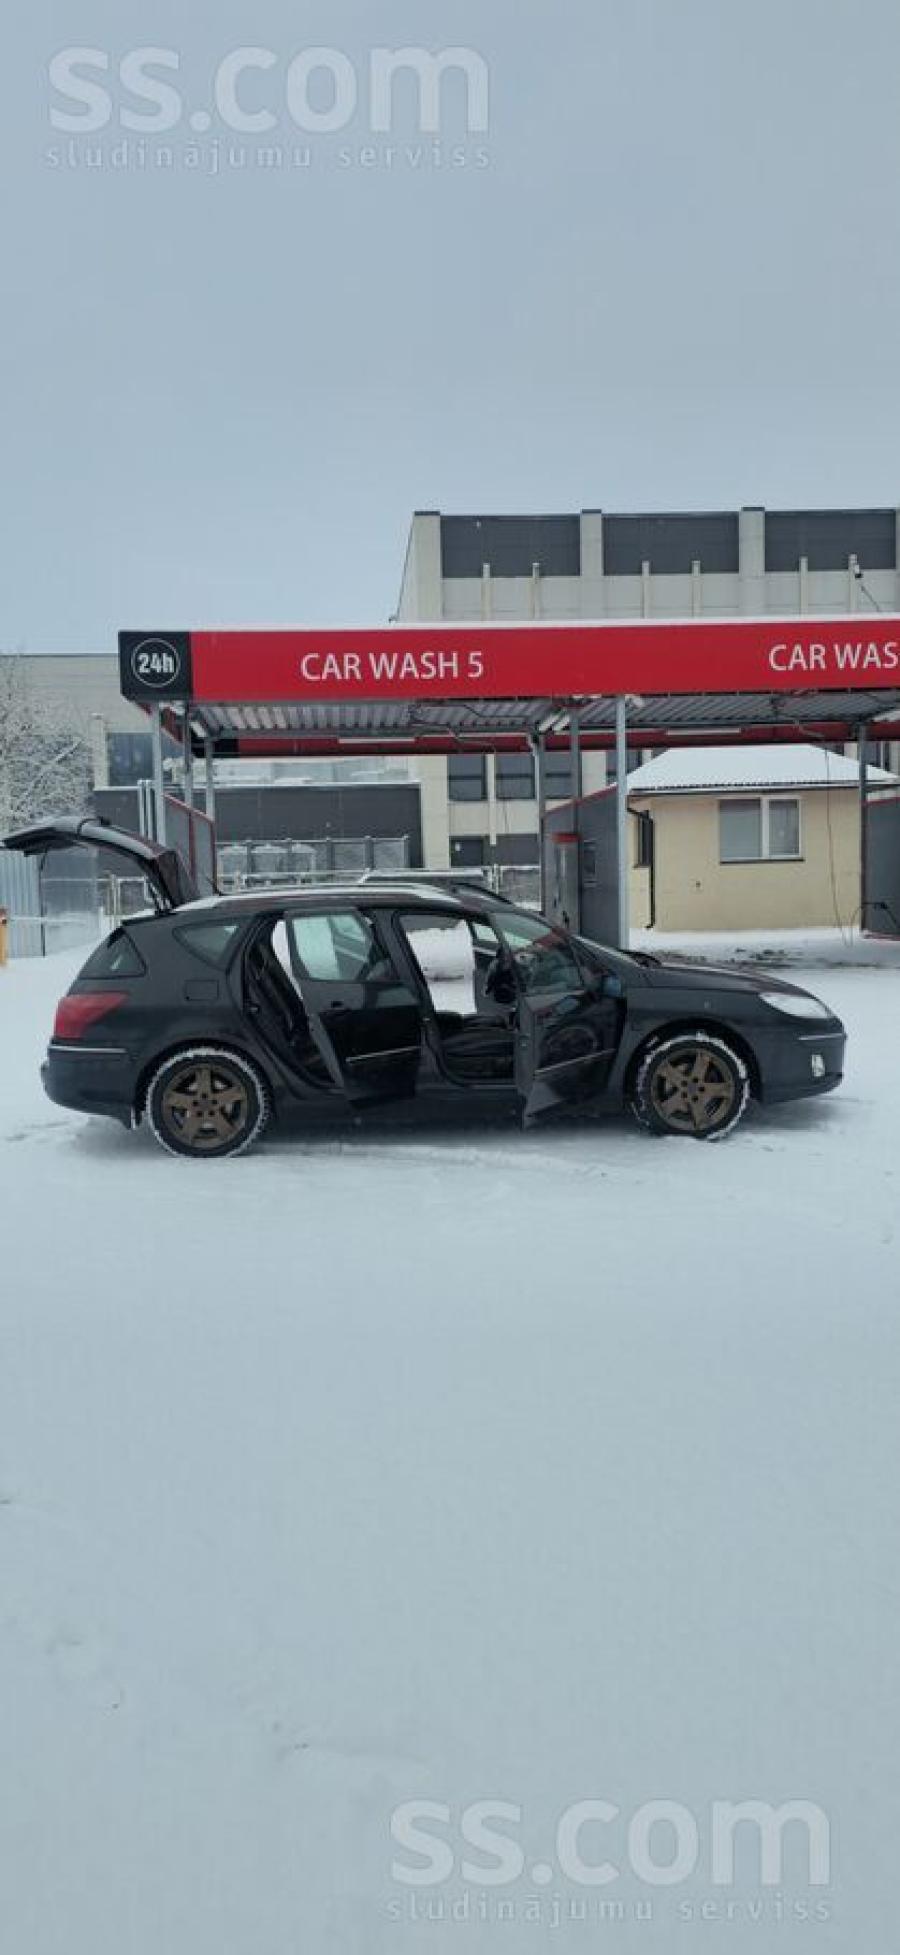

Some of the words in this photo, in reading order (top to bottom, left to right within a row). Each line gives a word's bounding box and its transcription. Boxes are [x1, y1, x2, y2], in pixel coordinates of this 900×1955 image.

[138, 652, 175, 674] 24h
[300, 652, 361, 681] CAR
[368, 651, 459, 680] WASH
[467, 650, 485, 678] 5
[768, 644, 826, 671] CAR
[833, 641, 900, 670] WAS
